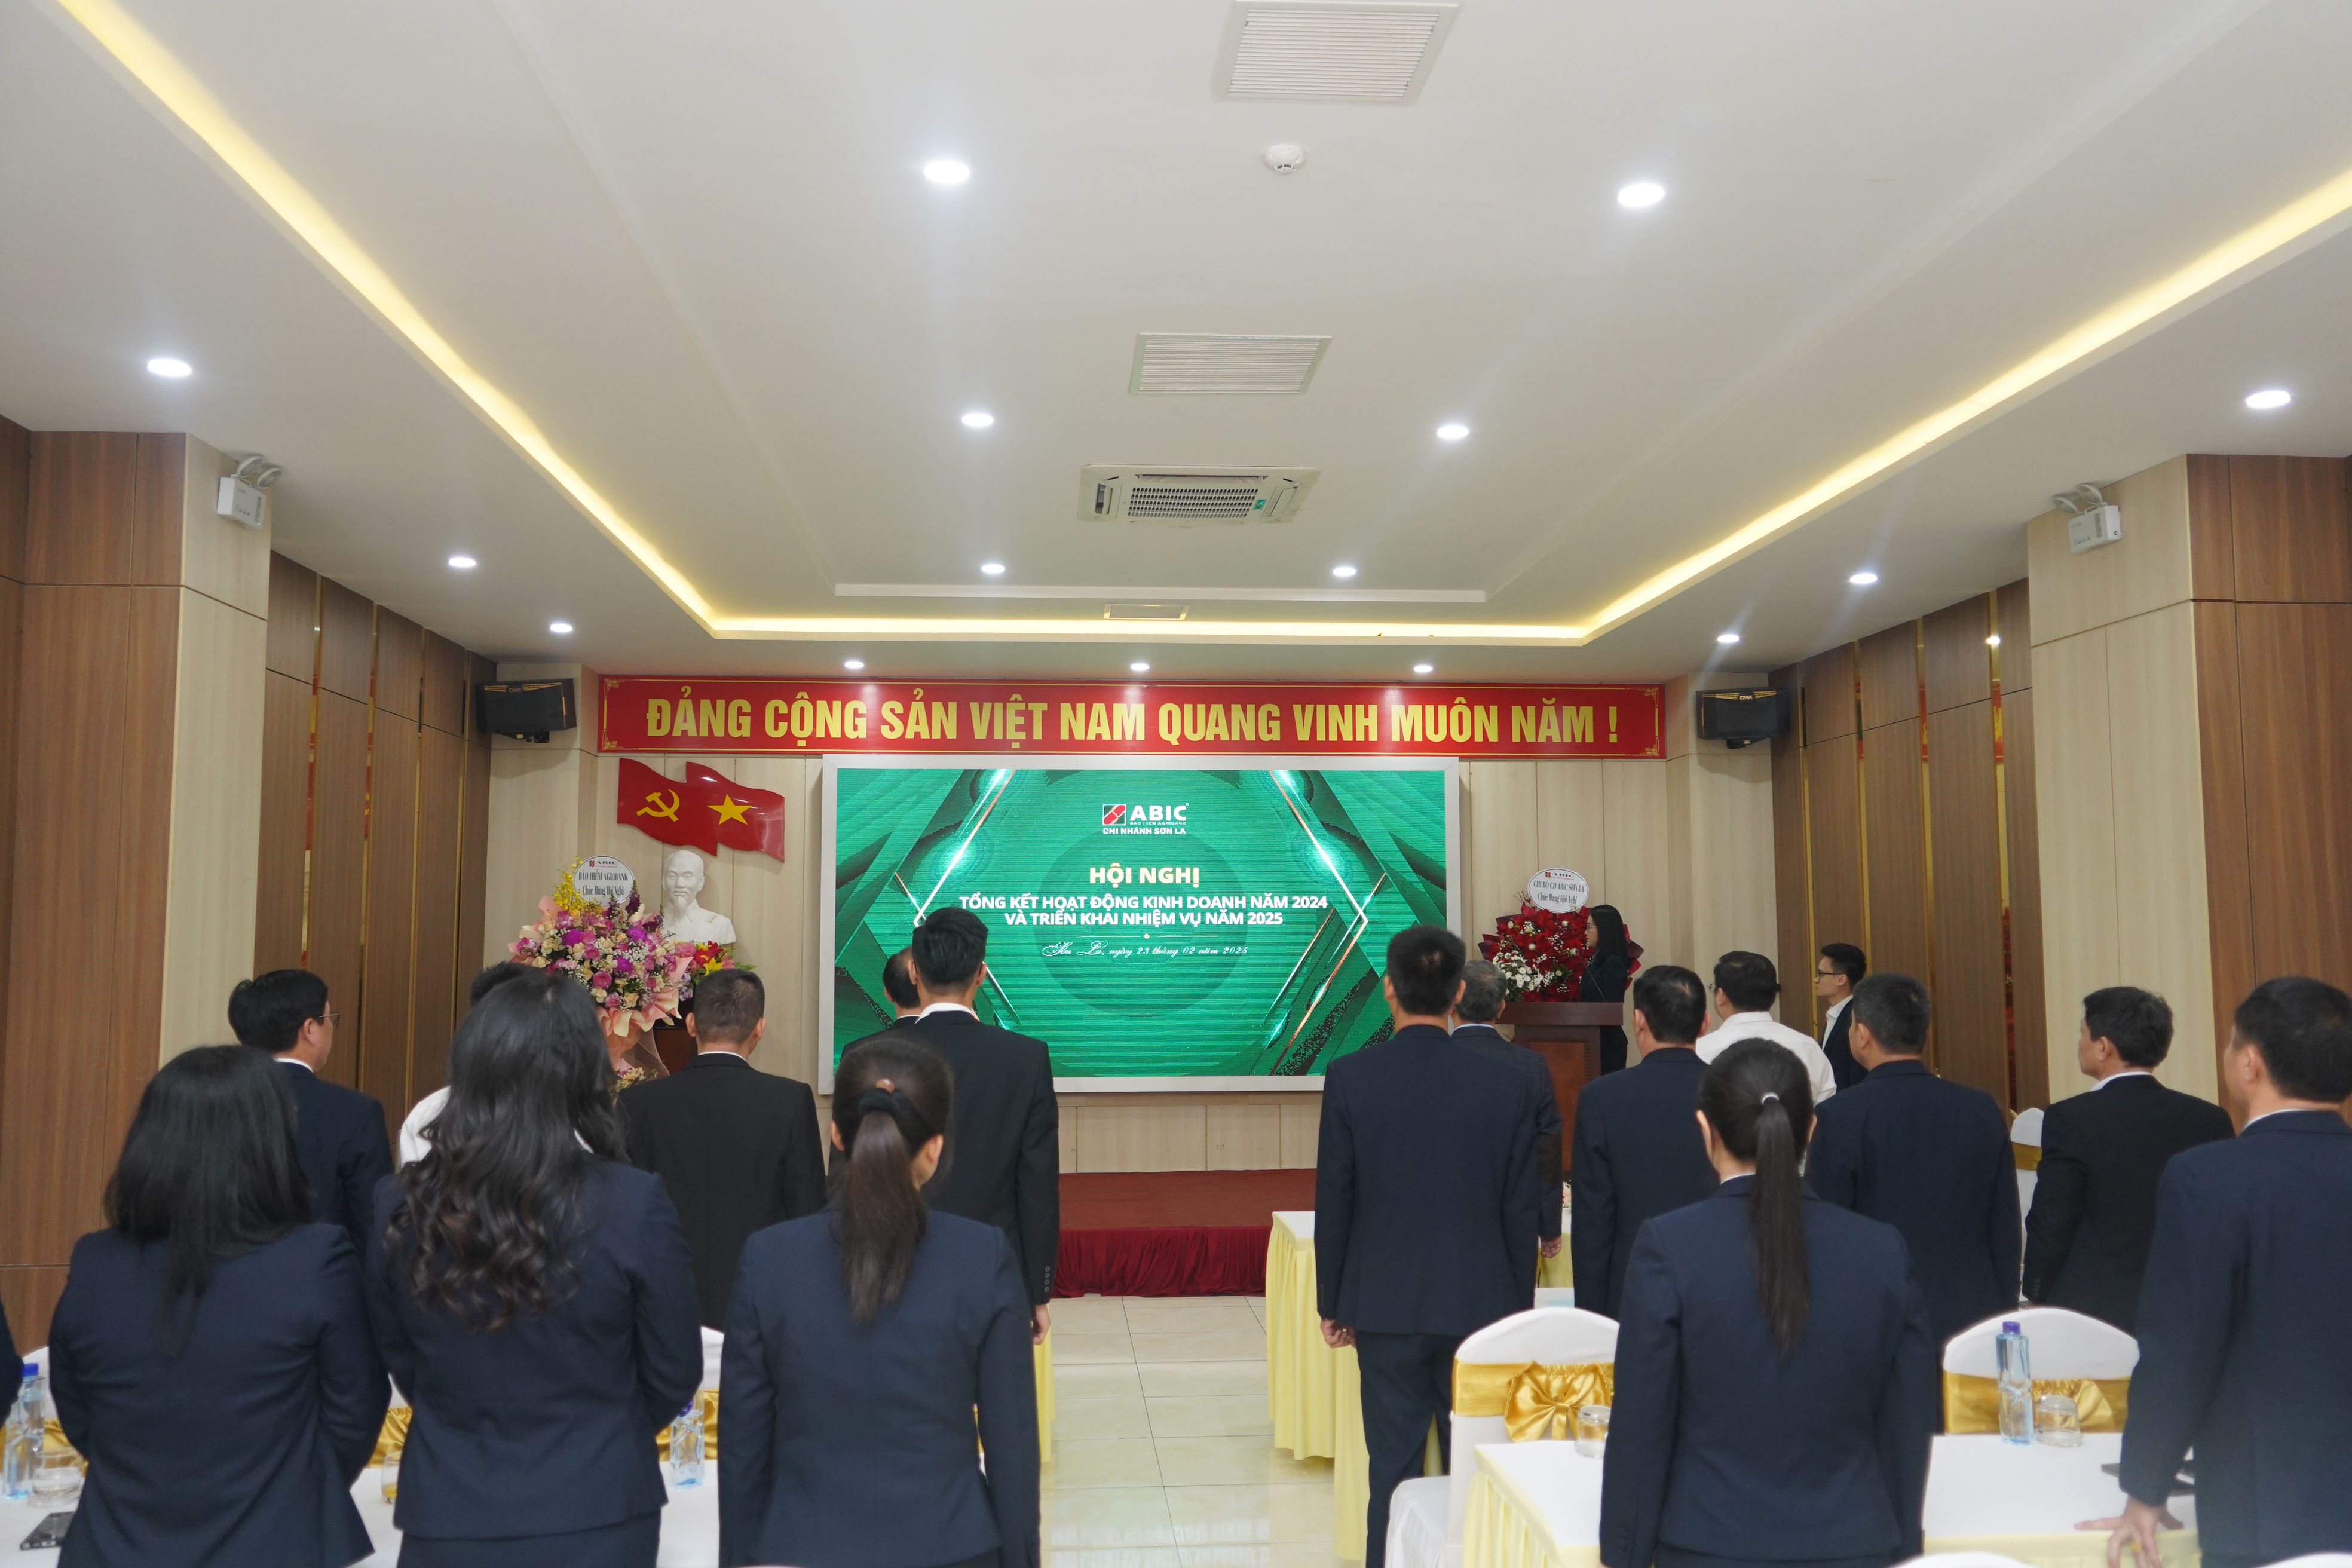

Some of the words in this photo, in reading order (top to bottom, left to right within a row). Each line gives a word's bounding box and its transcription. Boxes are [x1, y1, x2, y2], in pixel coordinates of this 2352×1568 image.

[647, 685, 752, 738] ĐẢNG
[765, 691, 868, 747] CỘNG
[881, 688, 957, 740] SẢN
[970, 694, 1048, 749] VIỆT
[1061, 702, 1146, 741] NAM
[1159, 702, 1281, 746] QUANG
[1293, 703, 1378, 742] VINH
[1391, 697, 1499, 742] MUÔN
[1512, 697, 1594, 743] NĂM
[1609, 706, 1618, 743] !
[1130, 804, 1187, 821] ABIC
[604, 872, 629, 881] AGRIBANK
[1089, 862, 1132, 888] HỘI
[1139, 867, 1199, 888] NGHỊ
[959, 892, 1006, 909] TỔNG
[1010, 892, 1039, 909] KẾT
[1042, 896, 1088, 912] HOẠT
[1089, 893, 1140, 912] ĐỘNG
[1143, 896, 1183, 909] KINH
[1187, 896, 1246, 909] DOANH
[1250, 892, 1288, 909] NĂM
[1291, 896, 1328, 908] 2024
[1004, 909, 1028, 925] VÀ
[1030, 908, 1076, 925] TRIỂN
[1080, 912, 1119, 925] KHAI
[1122, 909, 1175, 928] NHIỆM
[1179, 912, 1201, 928] VỤ
[1205, 909, 1244, 924] NĂM
[1247, 912, 1284, 924] 2025
[1109, 947, 1133, 958] ngày
[1152, 945, 1179, 958] tháng
